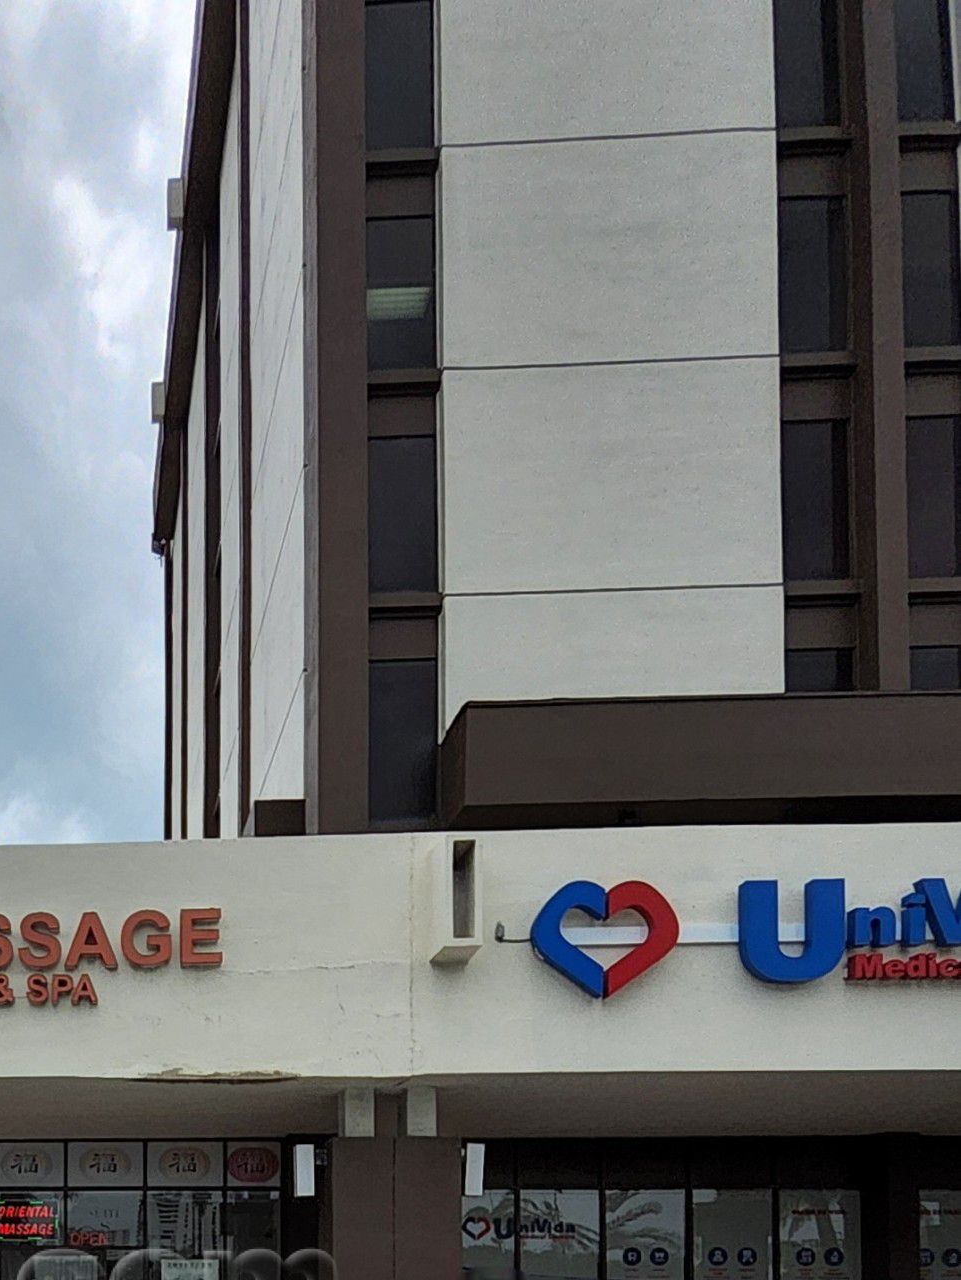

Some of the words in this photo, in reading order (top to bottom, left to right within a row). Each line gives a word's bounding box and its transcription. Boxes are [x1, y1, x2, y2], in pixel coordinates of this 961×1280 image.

[26, 973, 98, 1006] SPA
[10, 1152, 39, 1175] 福
[89, 1152, 118, 1175] 福
[168, 1151, 197, 1173] 福
[70, 1231, 109, 1246] OPEN
